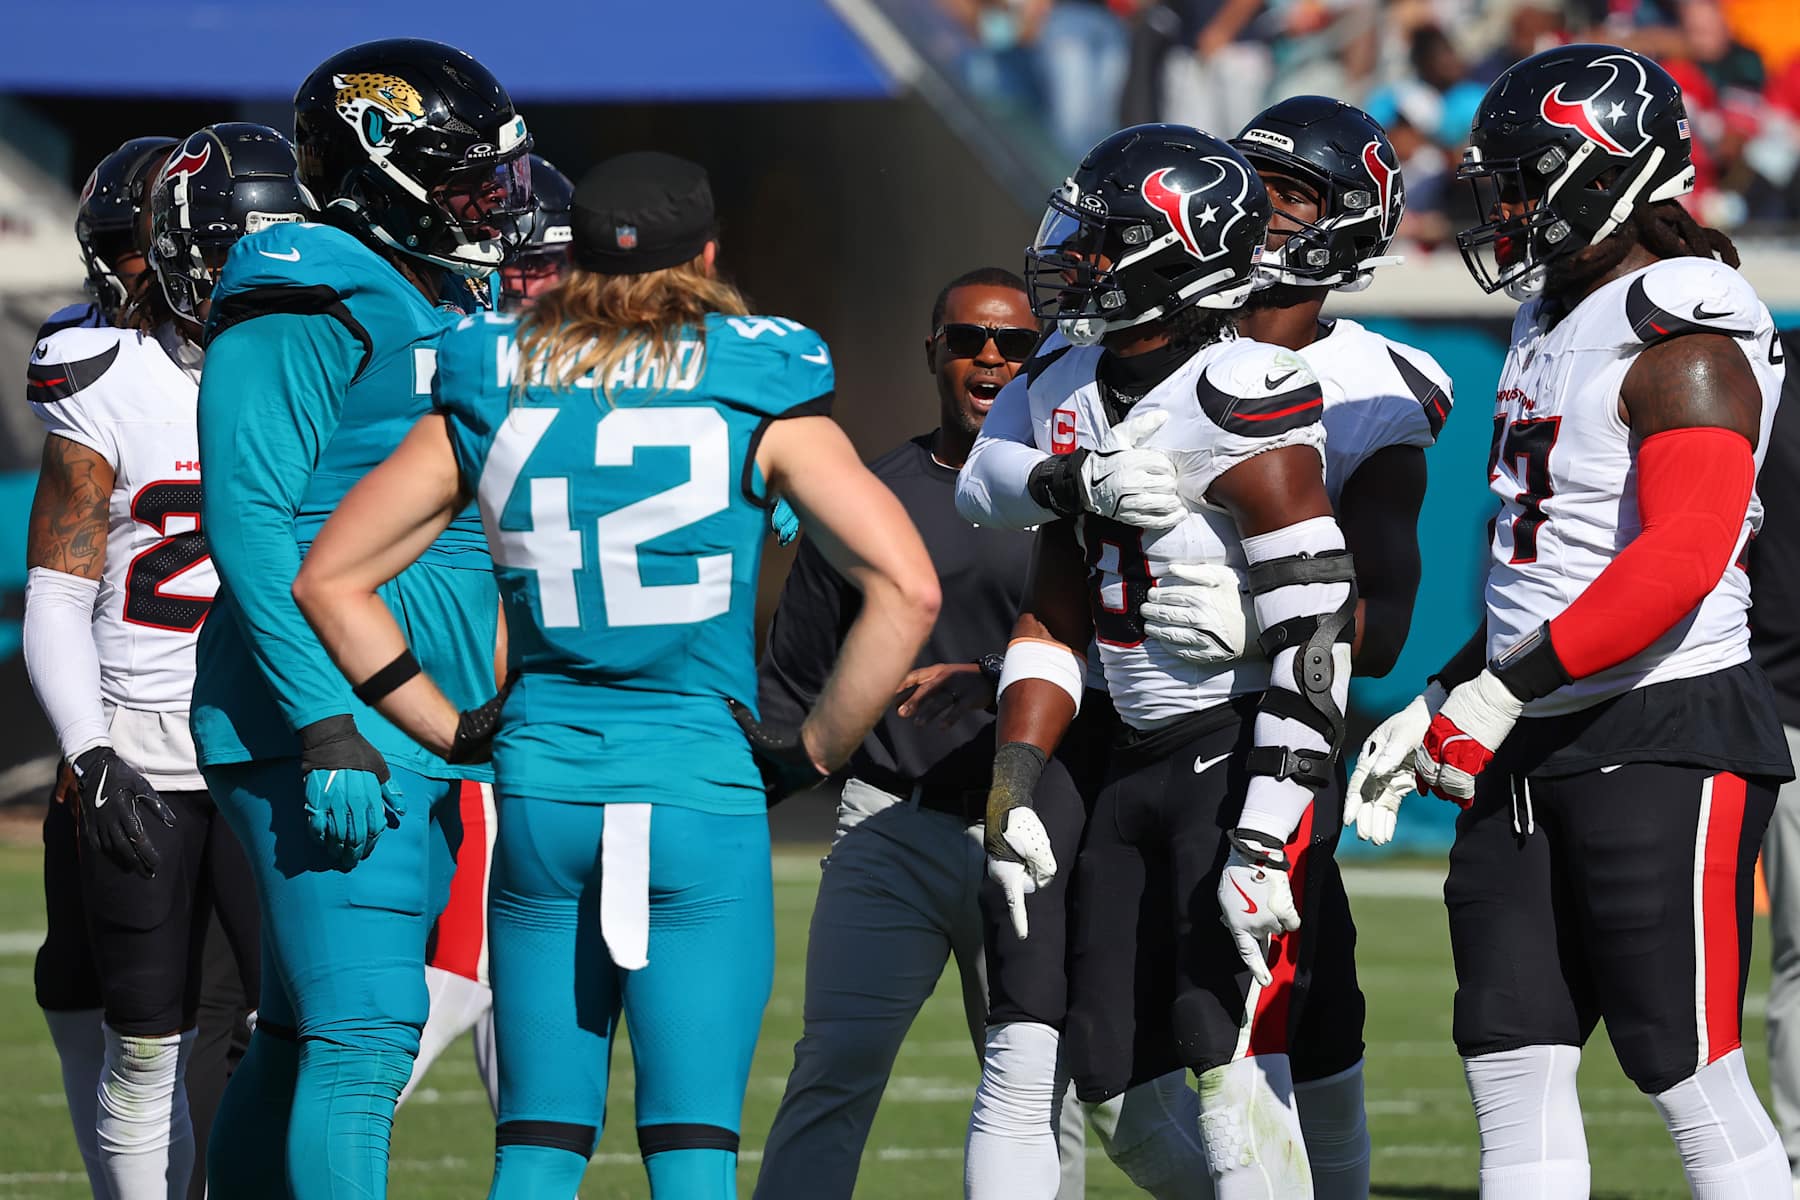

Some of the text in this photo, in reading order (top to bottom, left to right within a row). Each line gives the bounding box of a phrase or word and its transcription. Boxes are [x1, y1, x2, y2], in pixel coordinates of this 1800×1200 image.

[1250, 131, 1288, 145] TEXANS
[1052, 412, 1075, 445] C
[478, 407, 733, 628] 42
